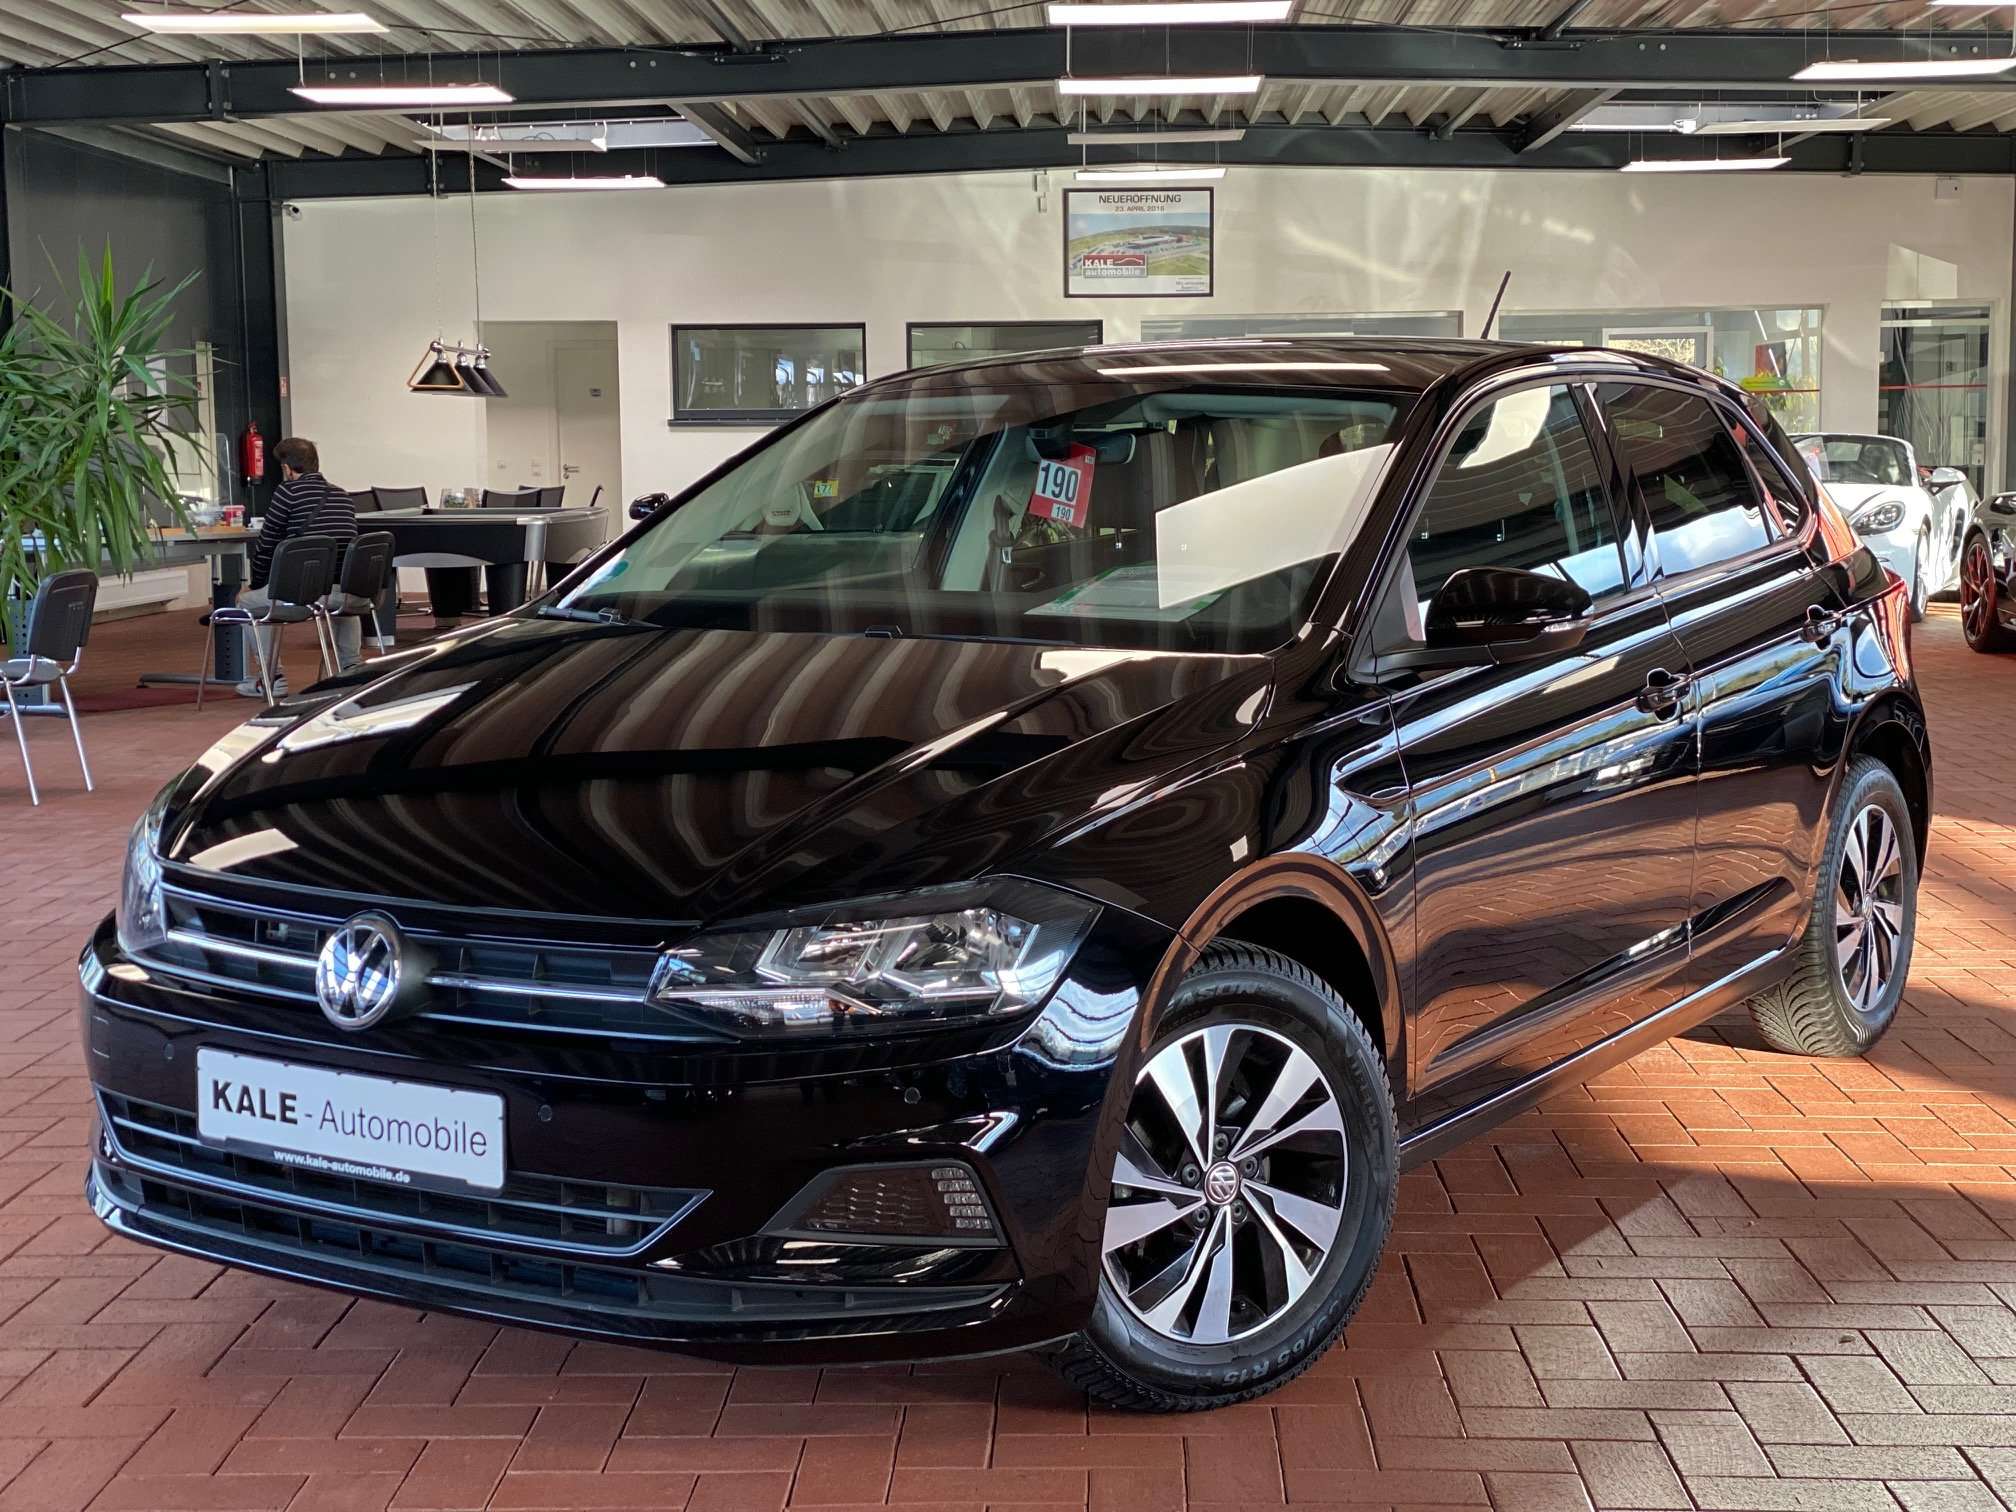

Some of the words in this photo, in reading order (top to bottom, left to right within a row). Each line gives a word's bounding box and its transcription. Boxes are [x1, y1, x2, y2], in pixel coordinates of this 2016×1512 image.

[1084, 258, 1114, 268] KALE
[1085, 267, 1141, 276] automobile
[1040, 462, 1079, 502] 190
[1055, 506, 1071, 521] 190
[273, 1150, 411, 1184] www.kale-automobile.de
